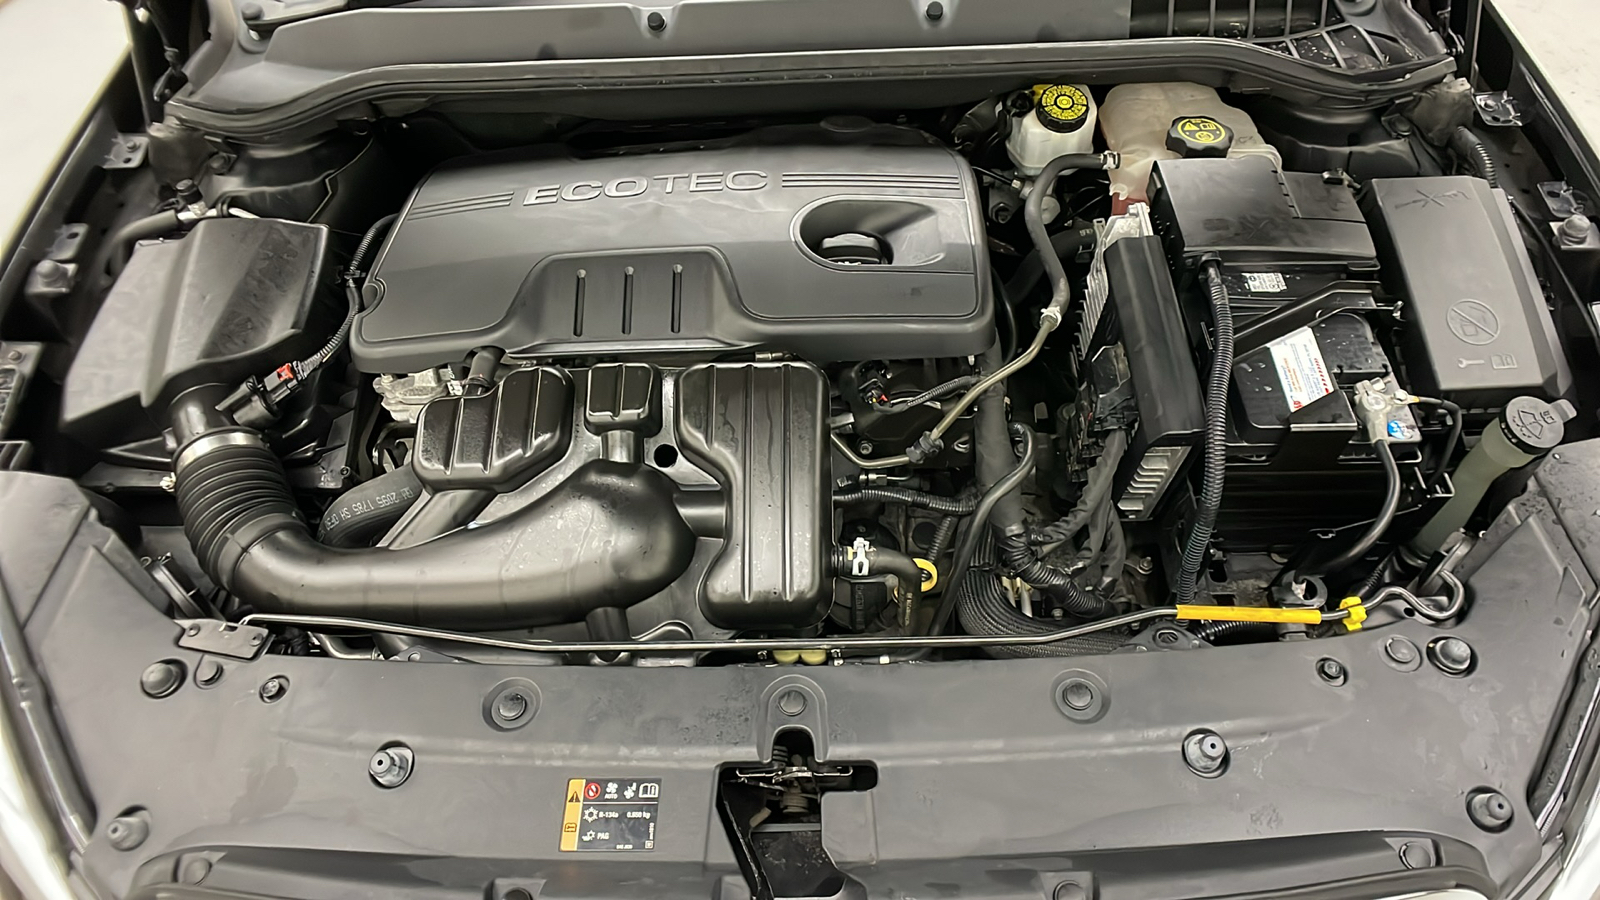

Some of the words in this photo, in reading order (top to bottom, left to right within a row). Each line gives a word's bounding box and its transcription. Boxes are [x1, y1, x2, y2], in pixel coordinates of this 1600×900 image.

[523, 171, 767, 206] ECOTEC
[352, 500, 375, 515] 1785
[376, 492, 399, 508] 2095
[643, 811, 651, 819] kg
[597, 832, 610, 840] PAG
